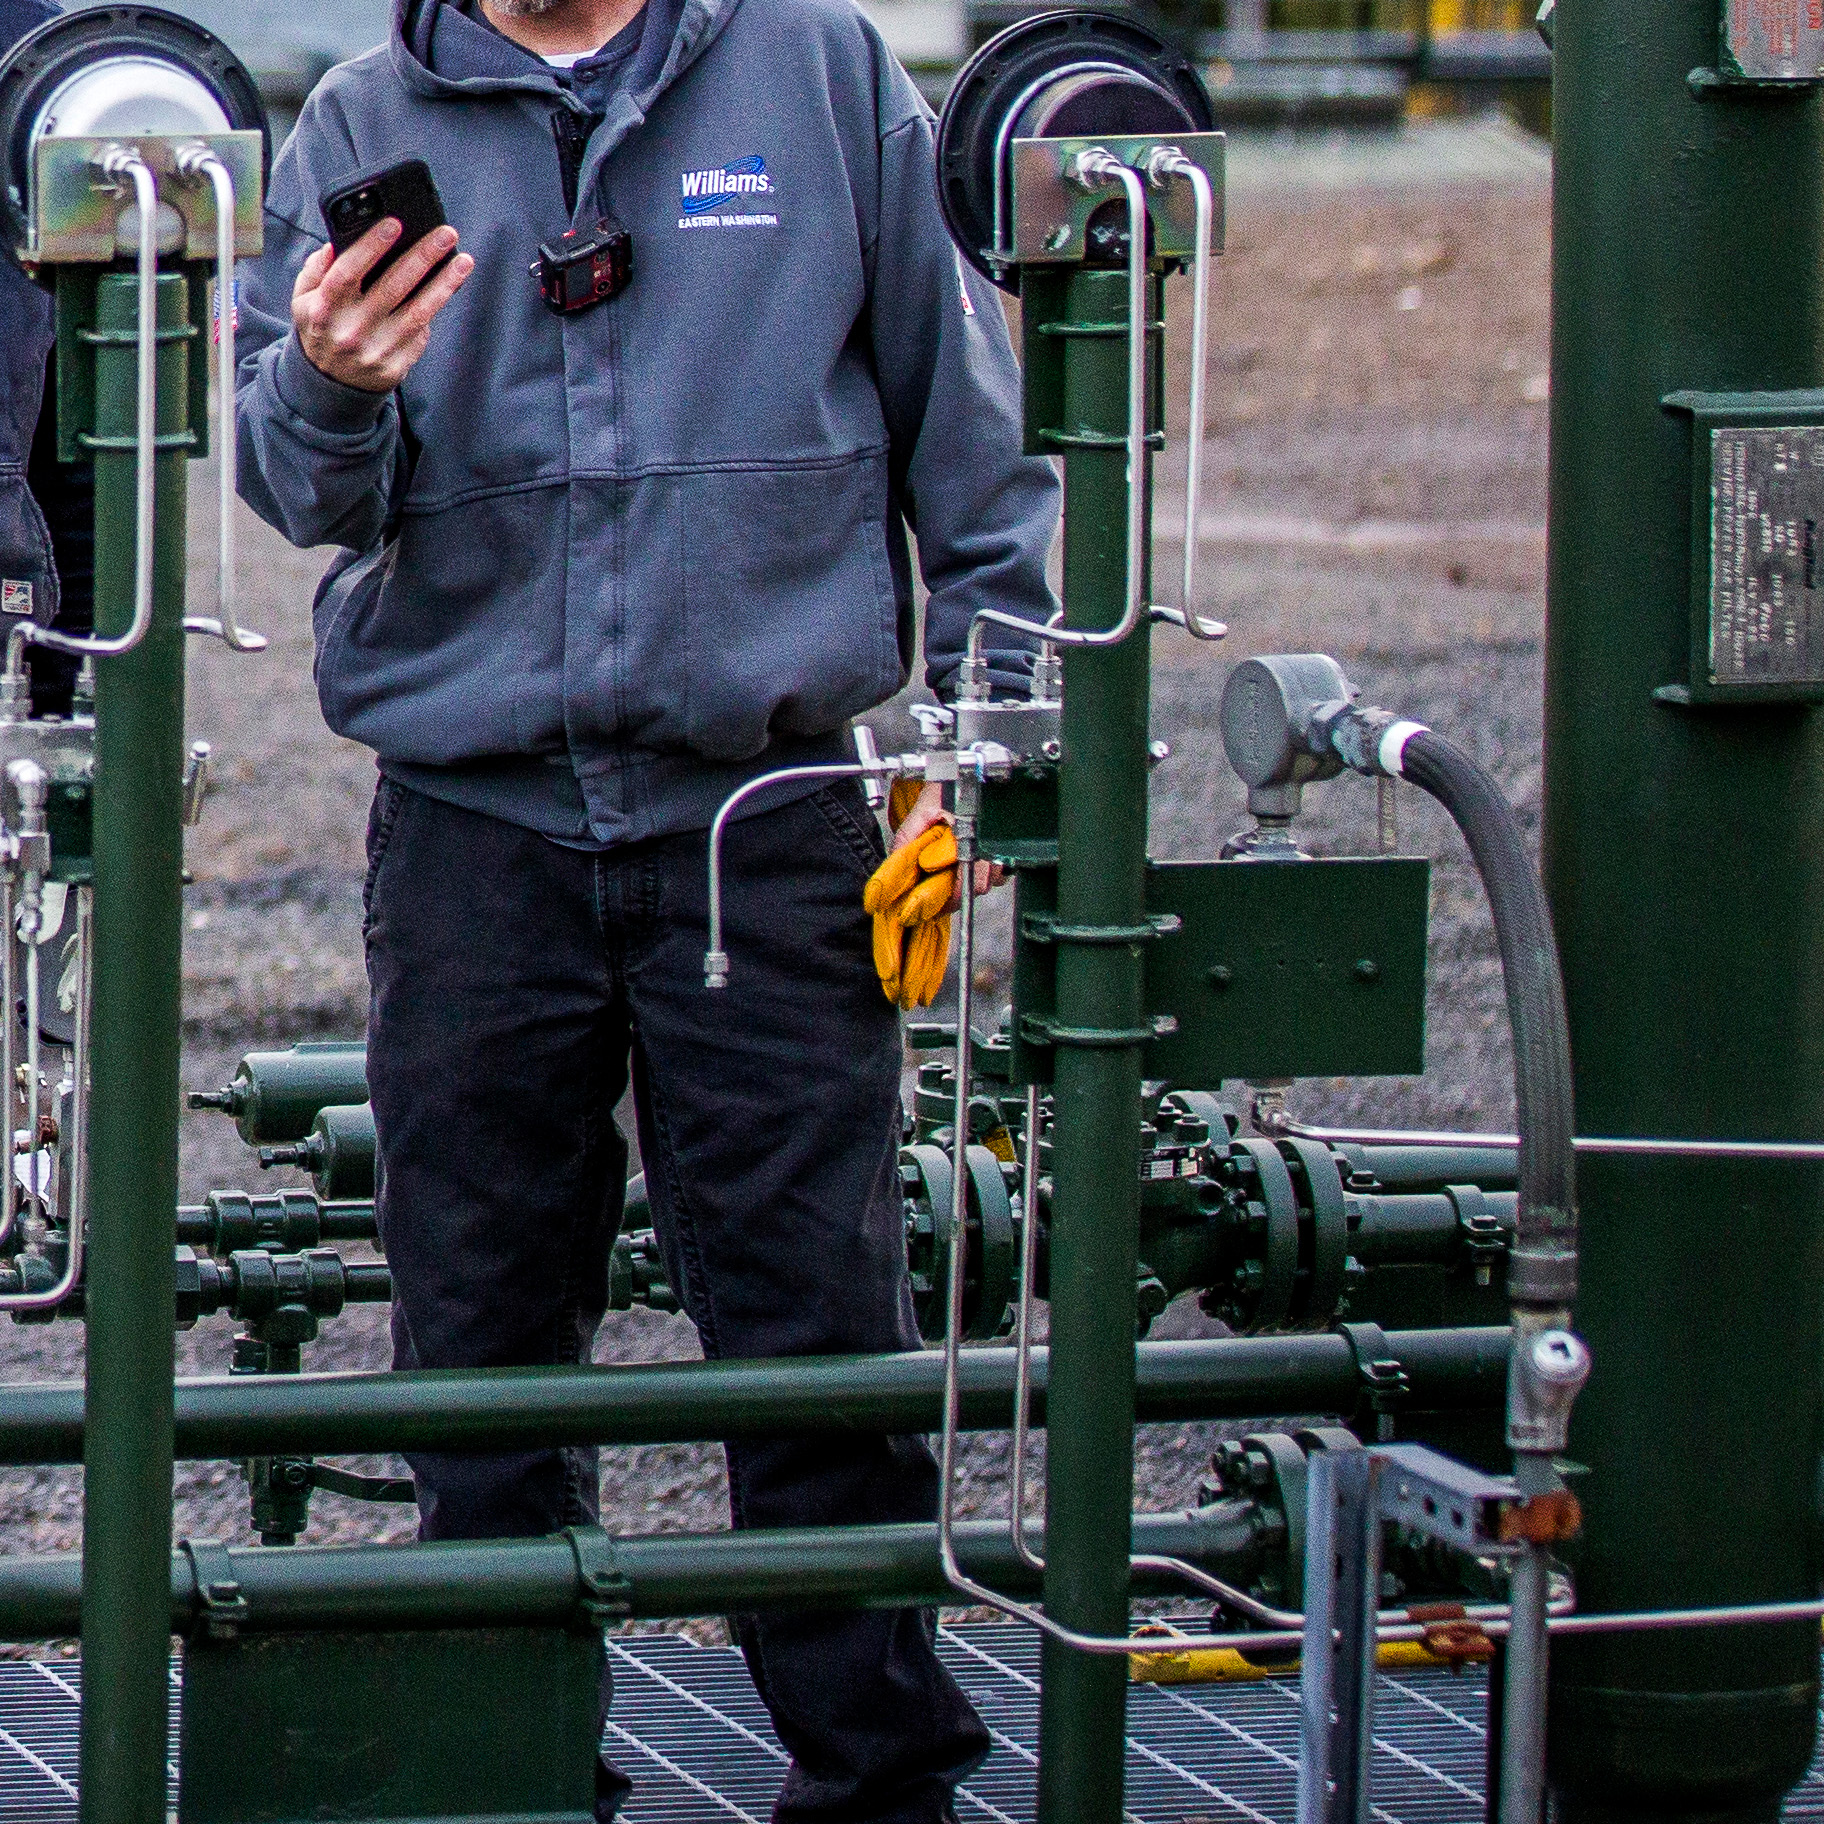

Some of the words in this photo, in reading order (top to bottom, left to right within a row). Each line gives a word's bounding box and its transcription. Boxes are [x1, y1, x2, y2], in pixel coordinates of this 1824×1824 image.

[682, 169, 770, 196] Williams
[678, 216, 720, 229] EASTERN
[721, 214, 778, 227] WASHINGTON
